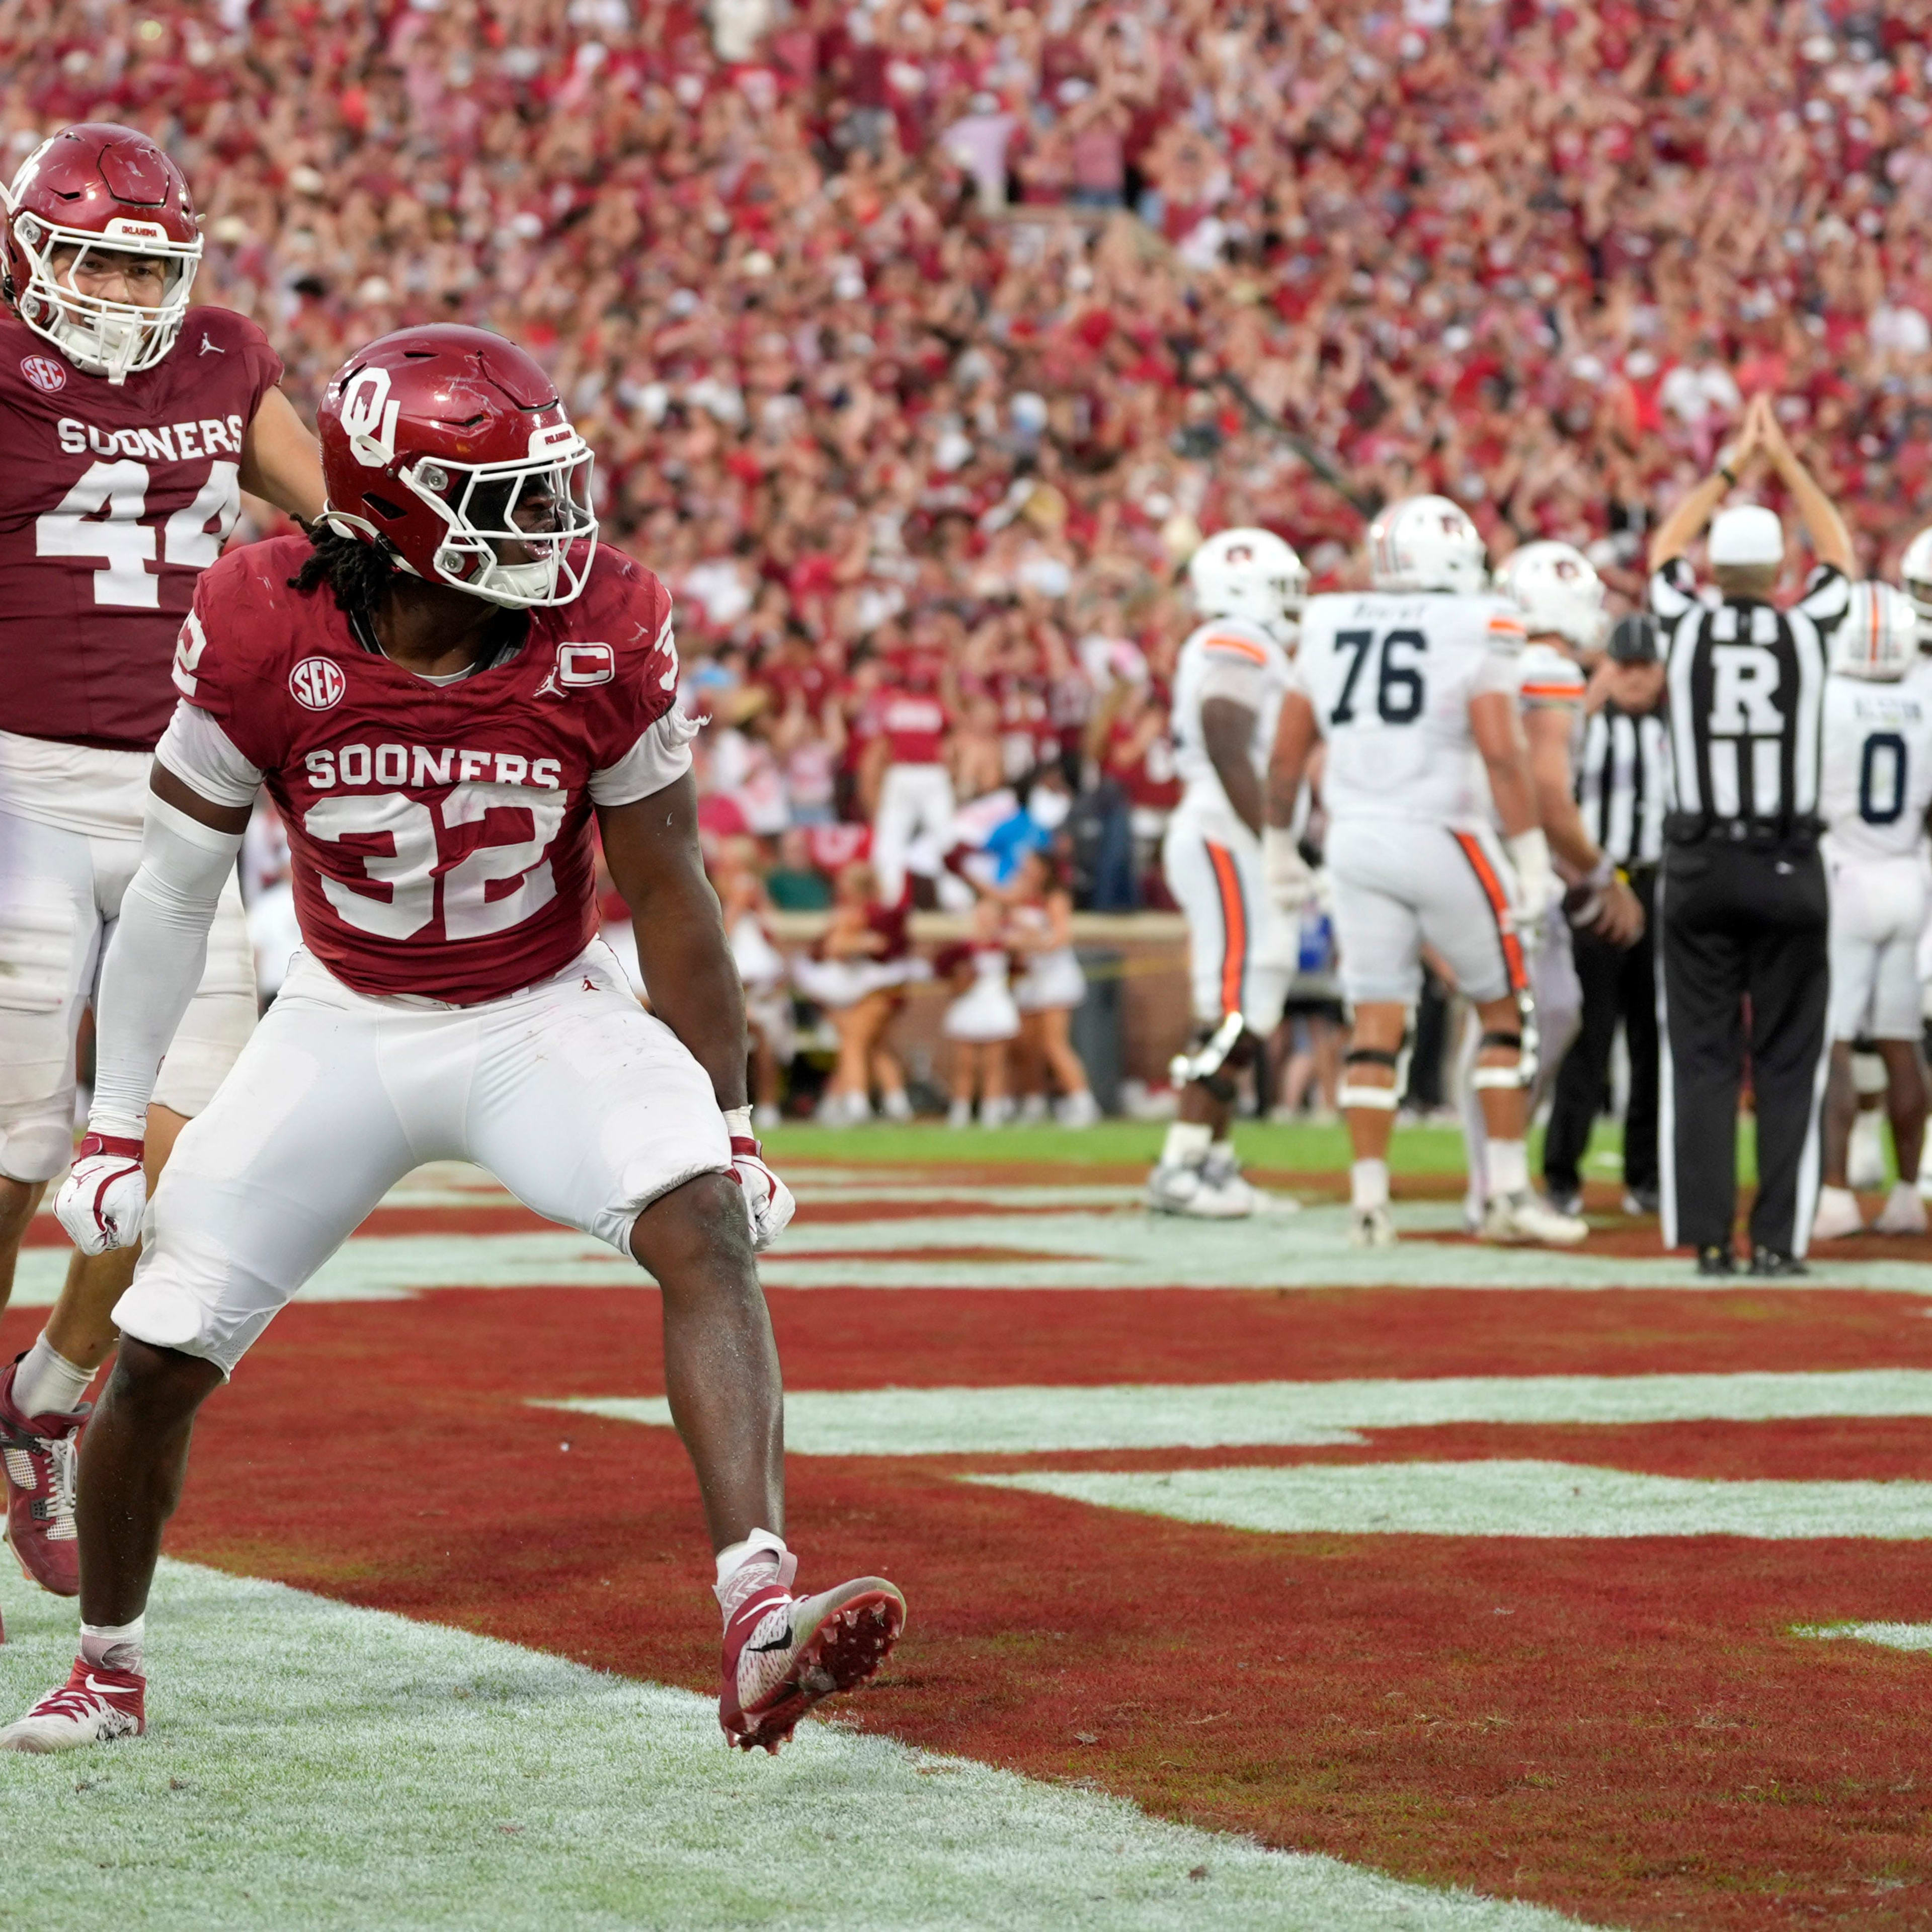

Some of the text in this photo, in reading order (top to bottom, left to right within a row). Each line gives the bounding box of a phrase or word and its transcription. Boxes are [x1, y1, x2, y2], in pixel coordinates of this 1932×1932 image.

[24, 358, 62, 389] SEC
[57, 414, 243, 461] SOONERS
[36, 458, 242, 608] 44
[294, 661, 341, 706] SEC
[558, 646, 609, 684] C
[1330, 629, 1428, 726] 76
[1708, 643, 1785, 735] R
[305, 743, 561, 790] SOONERS
[1859, 732, 1906, 825] 0
[303, 780, 568, 941] 32
